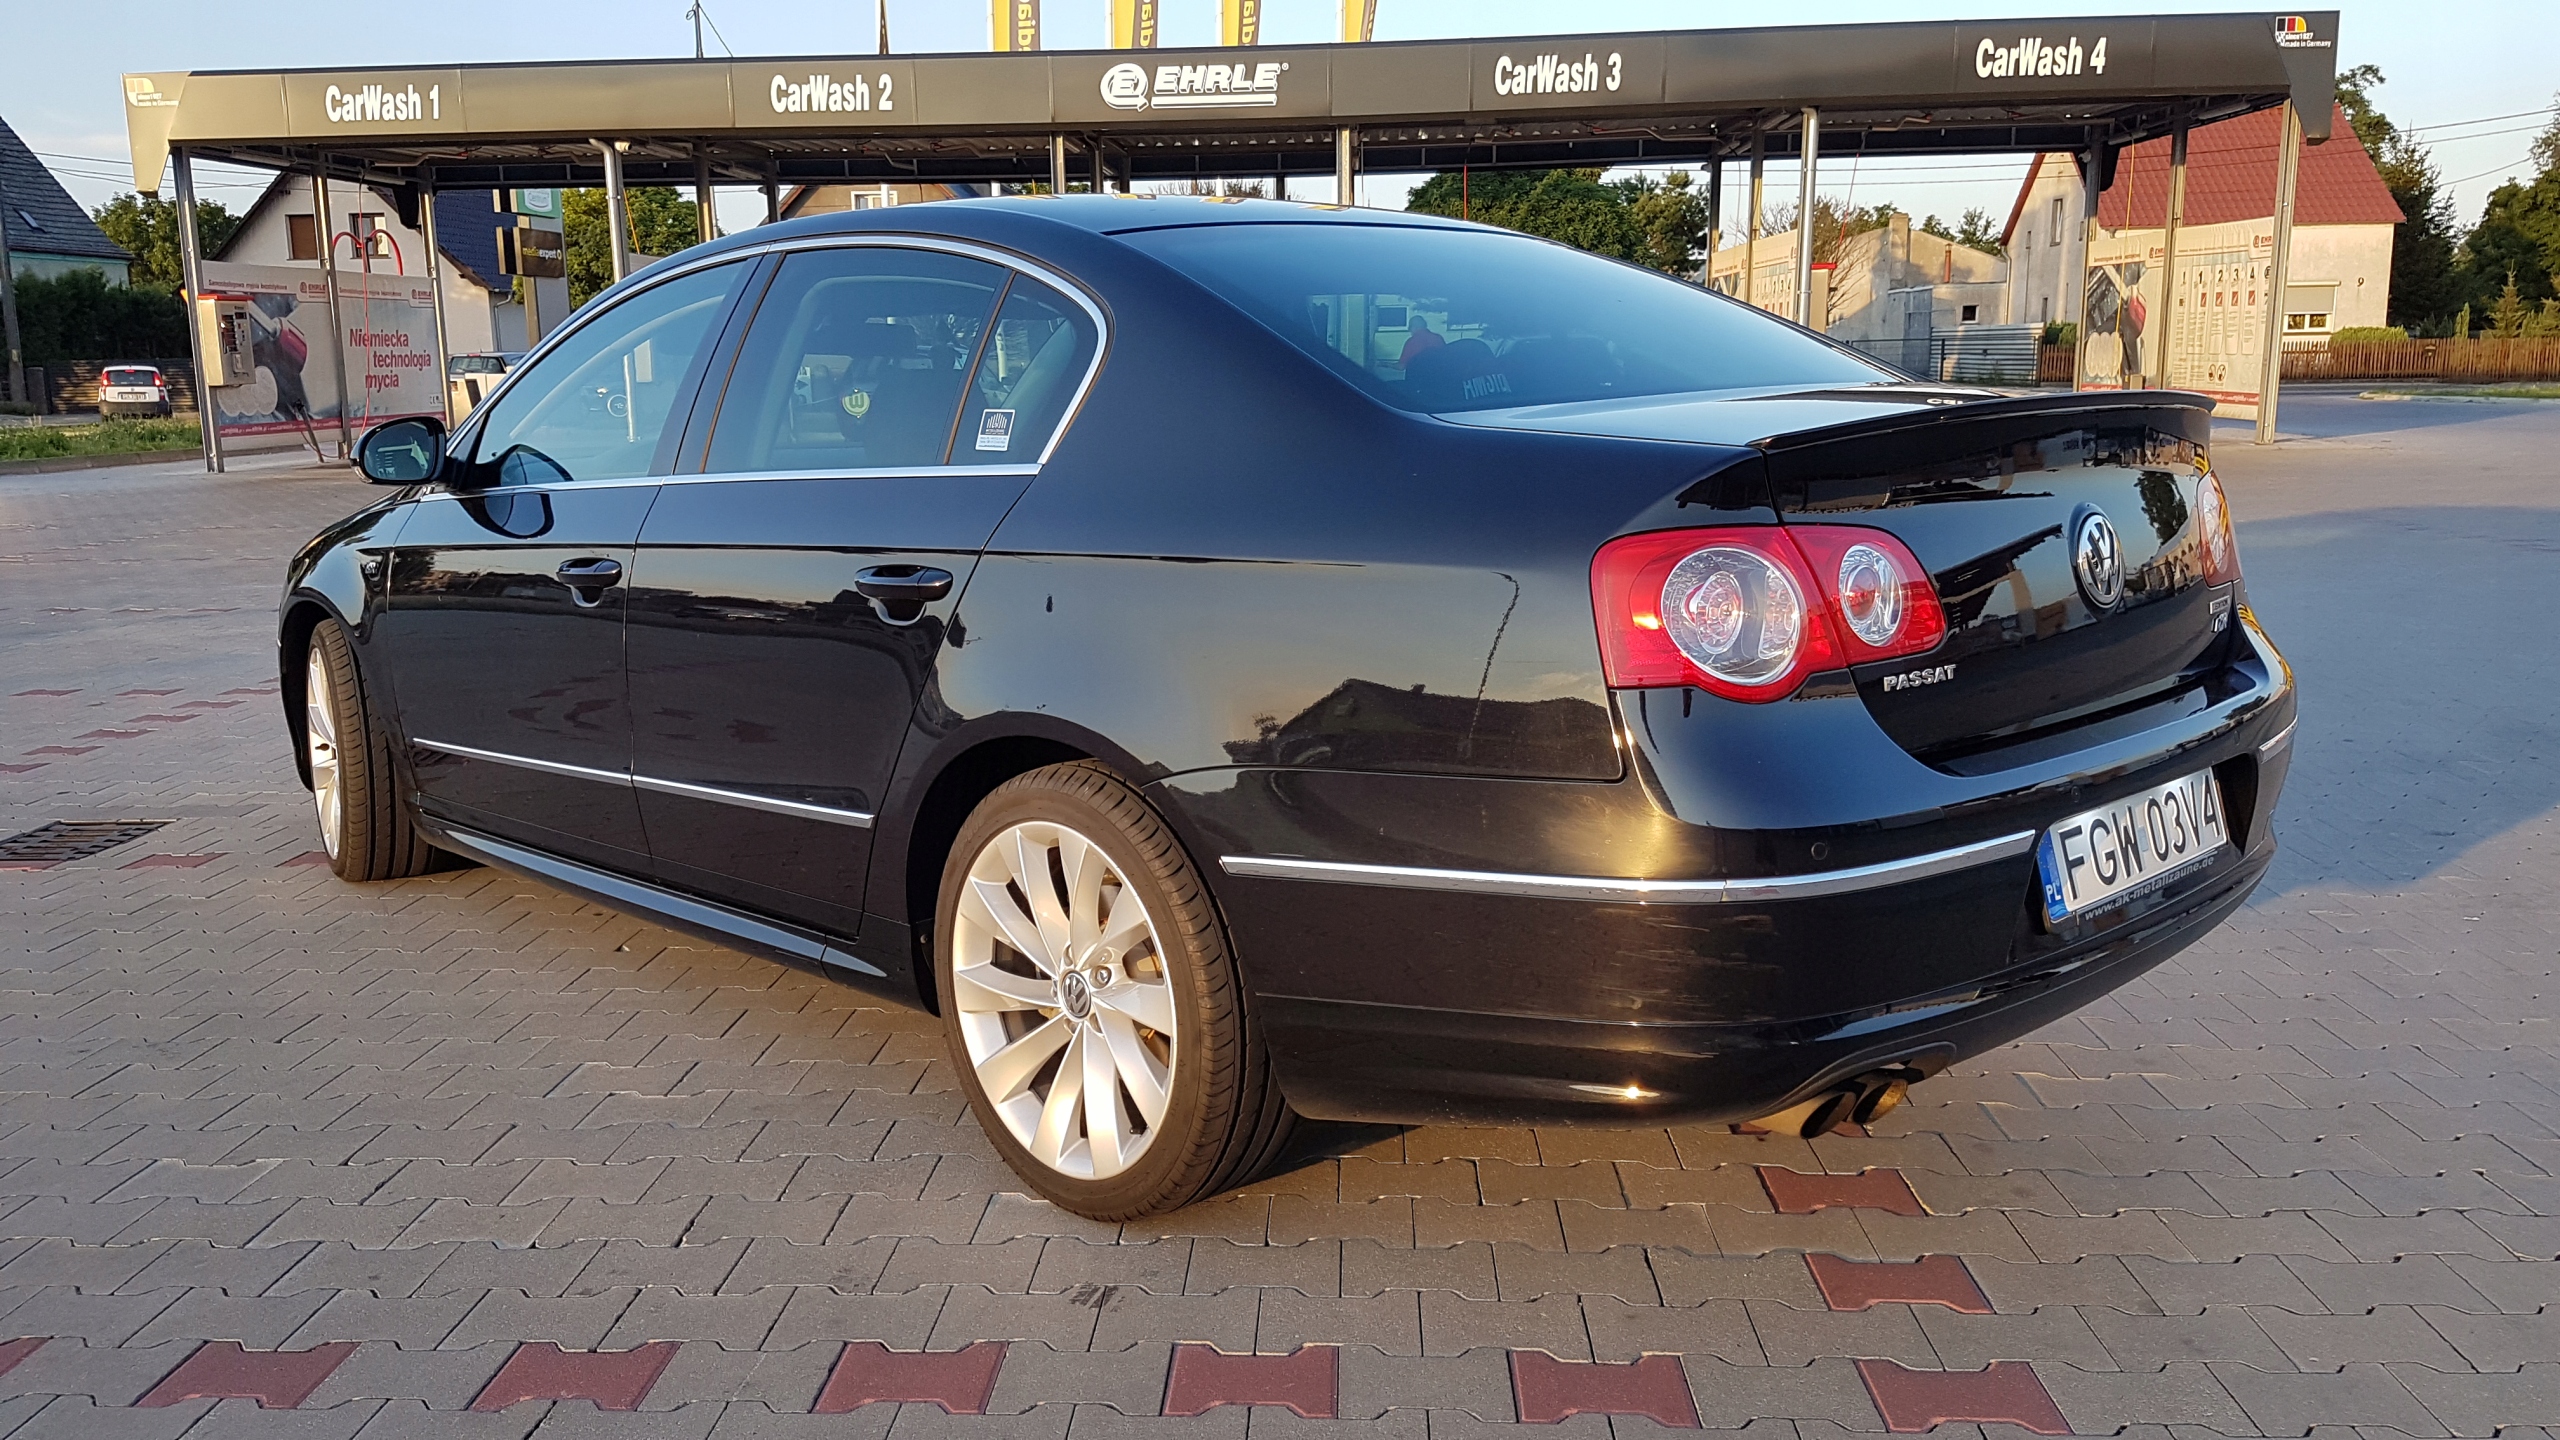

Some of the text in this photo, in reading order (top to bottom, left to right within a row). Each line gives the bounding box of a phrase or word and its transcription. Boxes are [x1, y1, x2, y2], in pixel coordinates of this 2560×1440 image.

[1976, 36, 2107, 78] CarWash 4
[1153, 62, 1281, 95] EHRLE
[1494, 52, 1622, 96] CarWash 3
[325, 84, 440, 122] CarWash 1
[770, 73, 893, 113] CarWash 2
[349, 328, 409, 348] Niemiecka
[373, 349, 431, 371] technologia
[365, 370, 400, 393] mycia
[1883, 664, 1957, 692] PASSAT
[2058, 805, 2144, 902] FGW
[2045, 884, 2062, 904] PL
